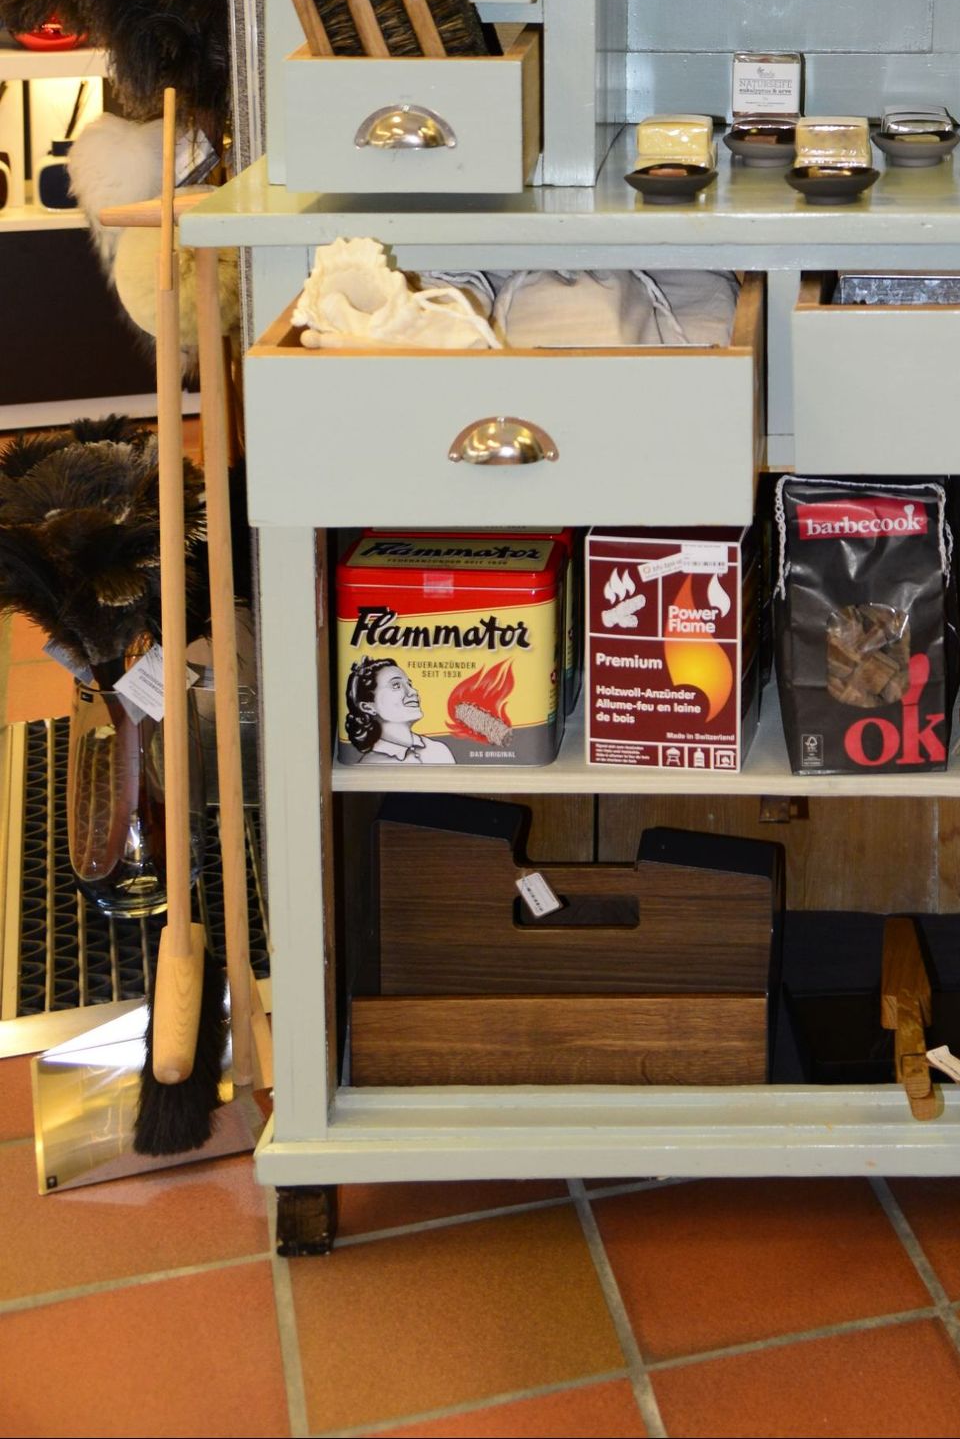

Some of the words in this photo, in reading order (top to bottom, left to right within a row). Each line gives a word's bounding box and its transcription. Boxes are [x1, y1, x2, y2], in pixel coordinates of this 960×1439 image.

[739, 79, 792, 88] NATURSEIFE
[806, 504, 921, 536] barbecook
[360, 542, 541, 560] Flammator
[668, 605, 718, 621] Power
[350, 606, 530, 650] Flammator
[669, 618, 715, 633] Flame
[407, 660, 476, 669] FEUERANZÜNDER
[596, 653, 662, 669] Premium
[596, 685, 696, 700] Holzwoll-Anzünder
[596, 699, 654, 711] Allume-feu
[657, 704, 671, 712] en
[674, 703, 701, 713] laine
[844, 653, 945, 766] ok
[596, 712, 610, 722] de
[613, 713, 635, 723] bois
[695, 733, 735, 741] Switzerland
